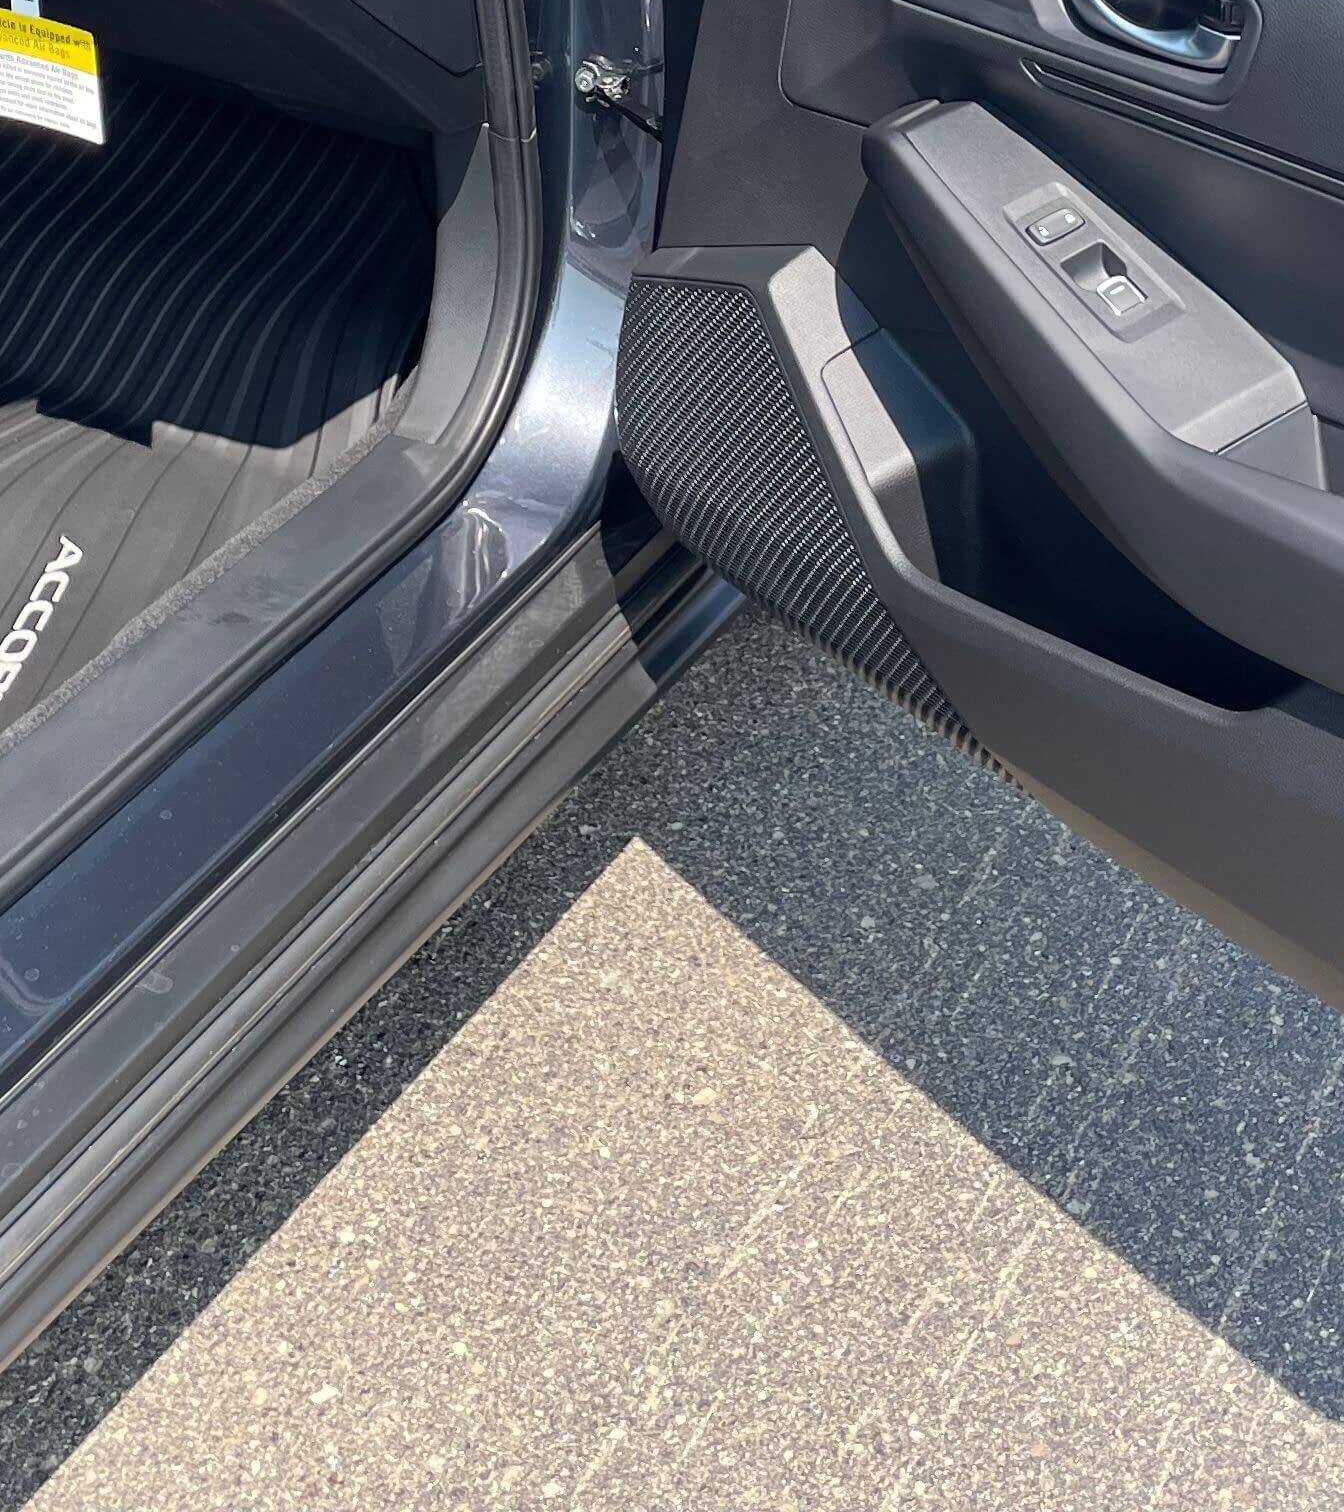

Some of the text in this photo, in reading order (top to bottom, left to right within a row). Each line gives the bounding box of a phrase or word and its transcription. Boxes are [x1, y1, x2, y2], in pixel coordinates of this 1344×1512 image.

[18, 23, 27, 34] is
[29, 24, 71, 45] Equipped
[33, 39, 46, 52] Air
[48, 43, 71, 59] Bags
